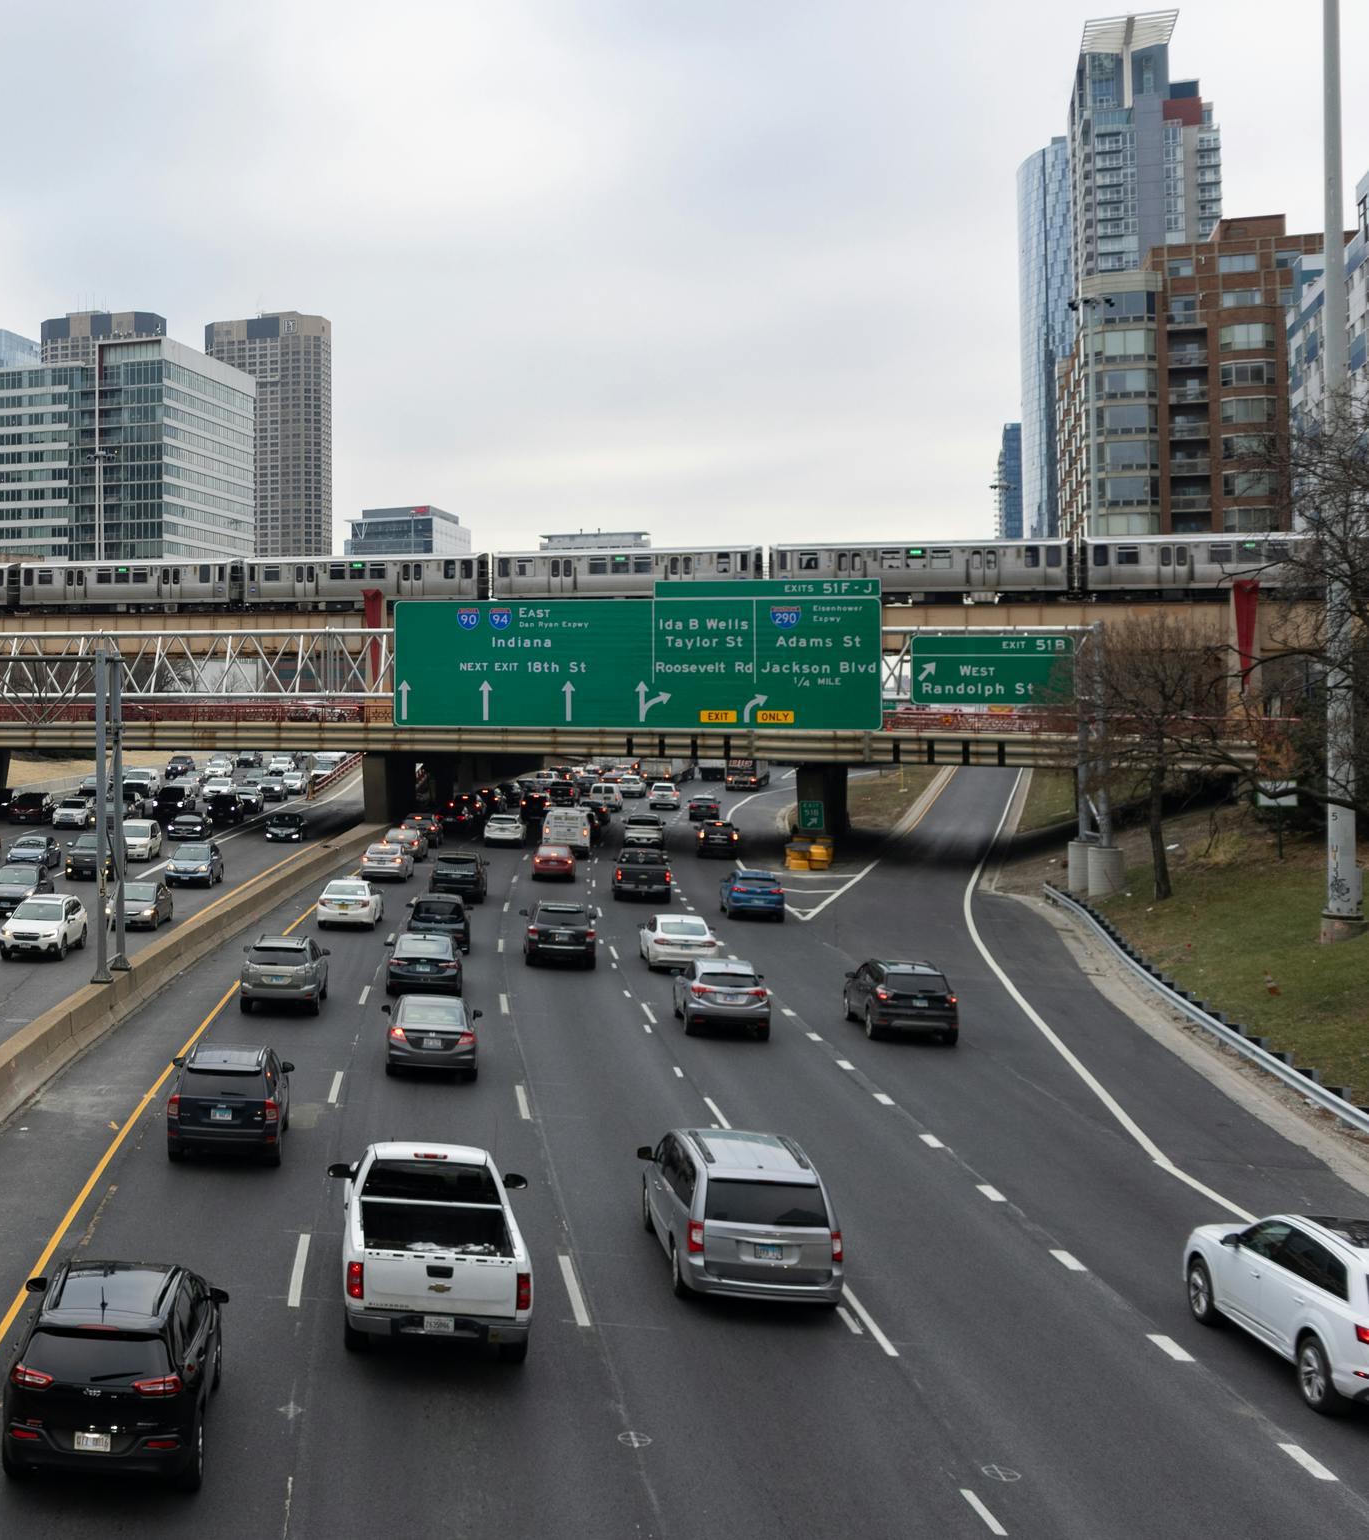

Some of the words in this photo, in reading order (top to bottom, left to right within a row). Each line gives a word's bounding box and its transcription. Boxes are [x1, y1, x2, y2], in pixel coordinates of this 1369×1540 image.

[784, 584, 815, 593] EXITS
[518, 607, 551, 618] EAST
[774, 612, 798, 625] 290
[460, 614, 477, 625] 90
[492, 614, 509, 625] 94
[538, 621, 559, 629] Ryan
[659, 618, 683, 630] Ida
[689, 618, 699, 630] B
[706, 618, 749, 630] Wells
[492, 636, 552, 648] Indiana
[665, 636, 719, 650] Taylor
[726, 636, 743, 647] St
[776, 635, 833, 648] Adams
[843, 635, 862, 648] St
[1002, 641, 1026, 649] EXIT
[1035, 639, 1066, 651] 51B
[459, 662, 489, 672] NEXT
[494, 662, 519, 672] EXIT
[527, 661, 560, 673] 18th
[569, 661, 587, 673] St
[655, 661, 726, 673] Roosevelt
[734, 661, 753, 673] Rd
[761, 661, 830, 673] Jackson
[839, 661, 877, 673] Blvd
[959, 665, 995, 677] WEST
[817, 677, 842, 686] MILE
[921, 682, 1005, 697] Randolph
[1014, 682, 1034, 695] St
[707, 711, 729, 721] EXIT
[761, 712, 790, 722] ONLY
